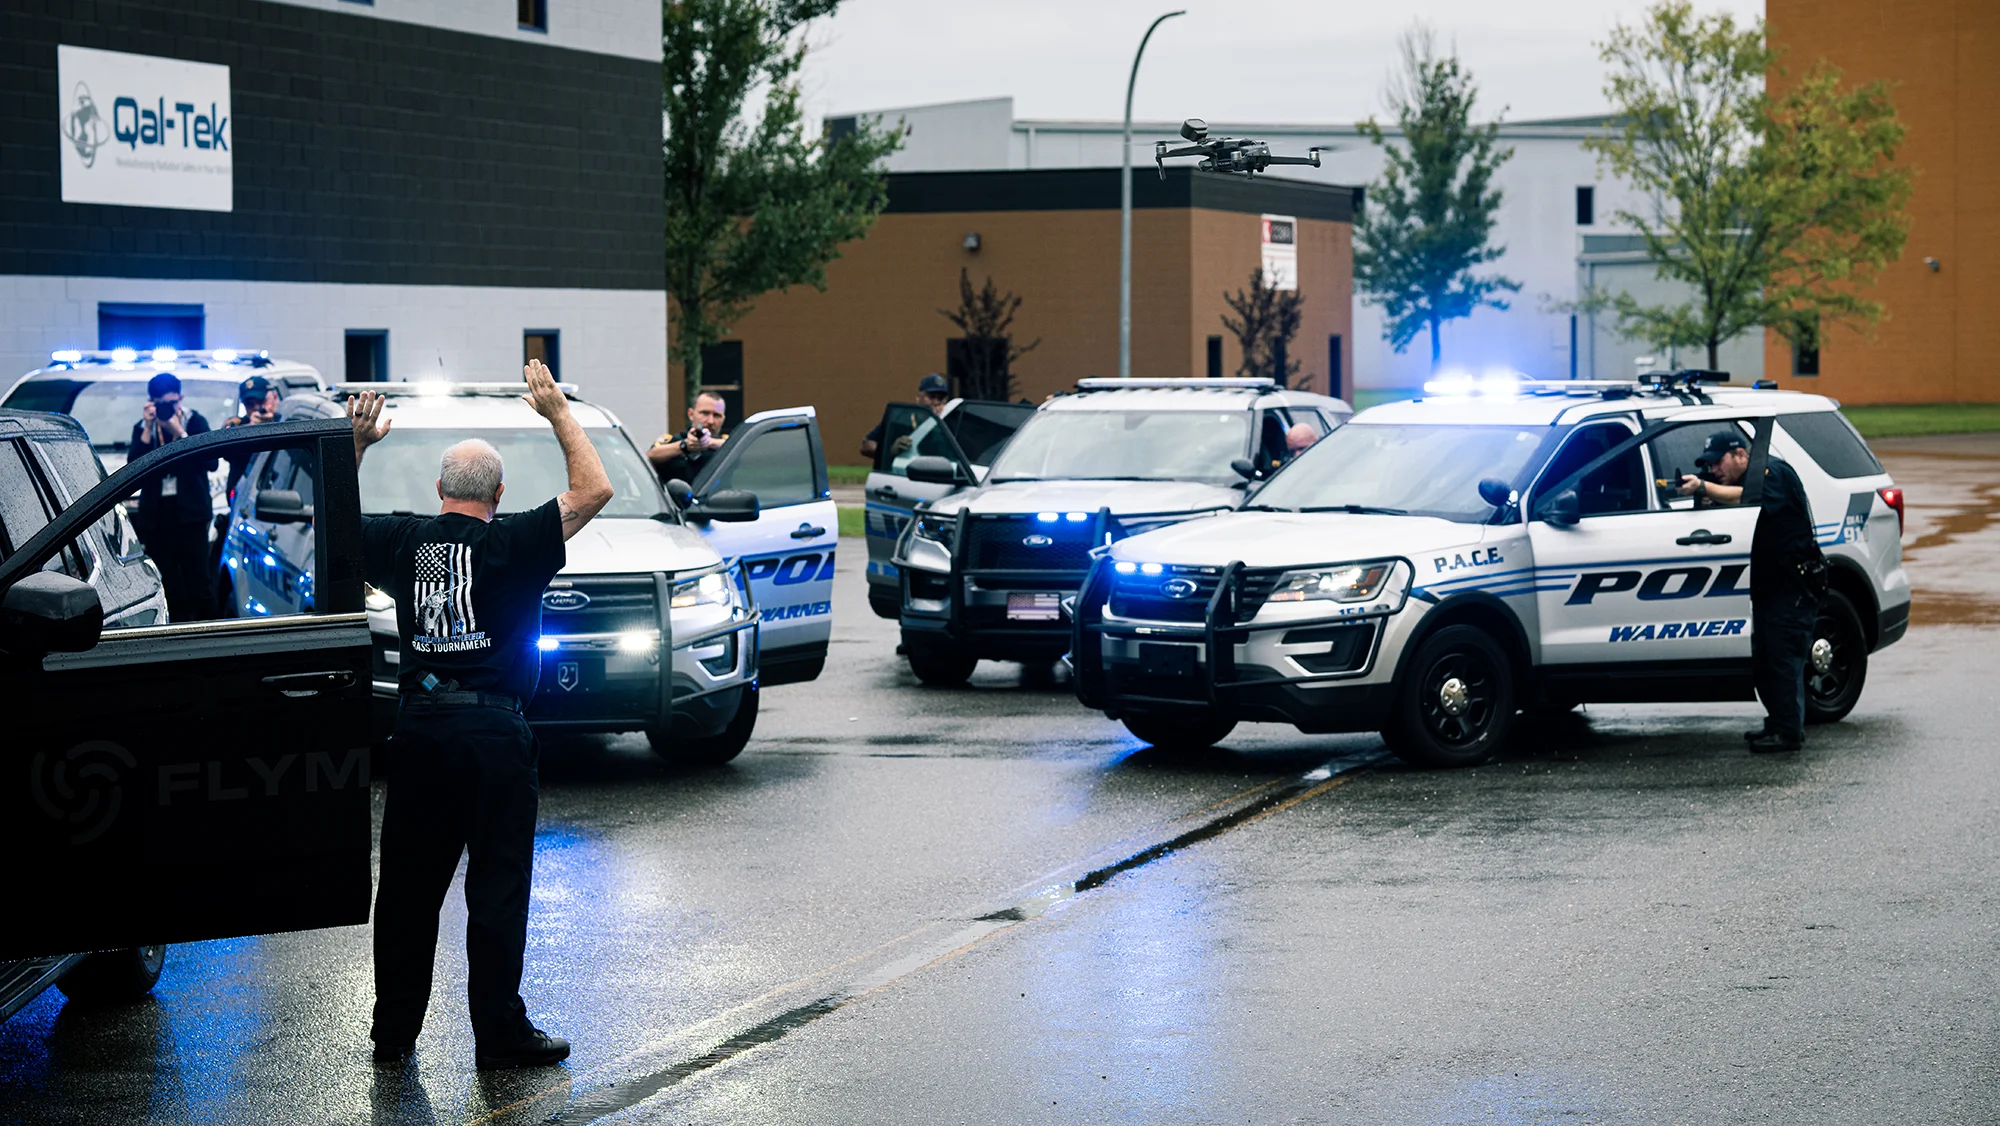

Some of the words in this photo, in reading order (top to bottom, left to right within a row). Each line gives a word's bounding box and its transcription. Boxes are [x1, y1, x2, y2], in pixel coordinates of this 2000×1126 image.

[113, 95, 228, 151] Qal-Tek
[1433, 547, 1504, 573] P.A.C.E.
[1608, 619, 1747, 643] WARNER
[432, 638, 492, 653] TOURNAMENT
